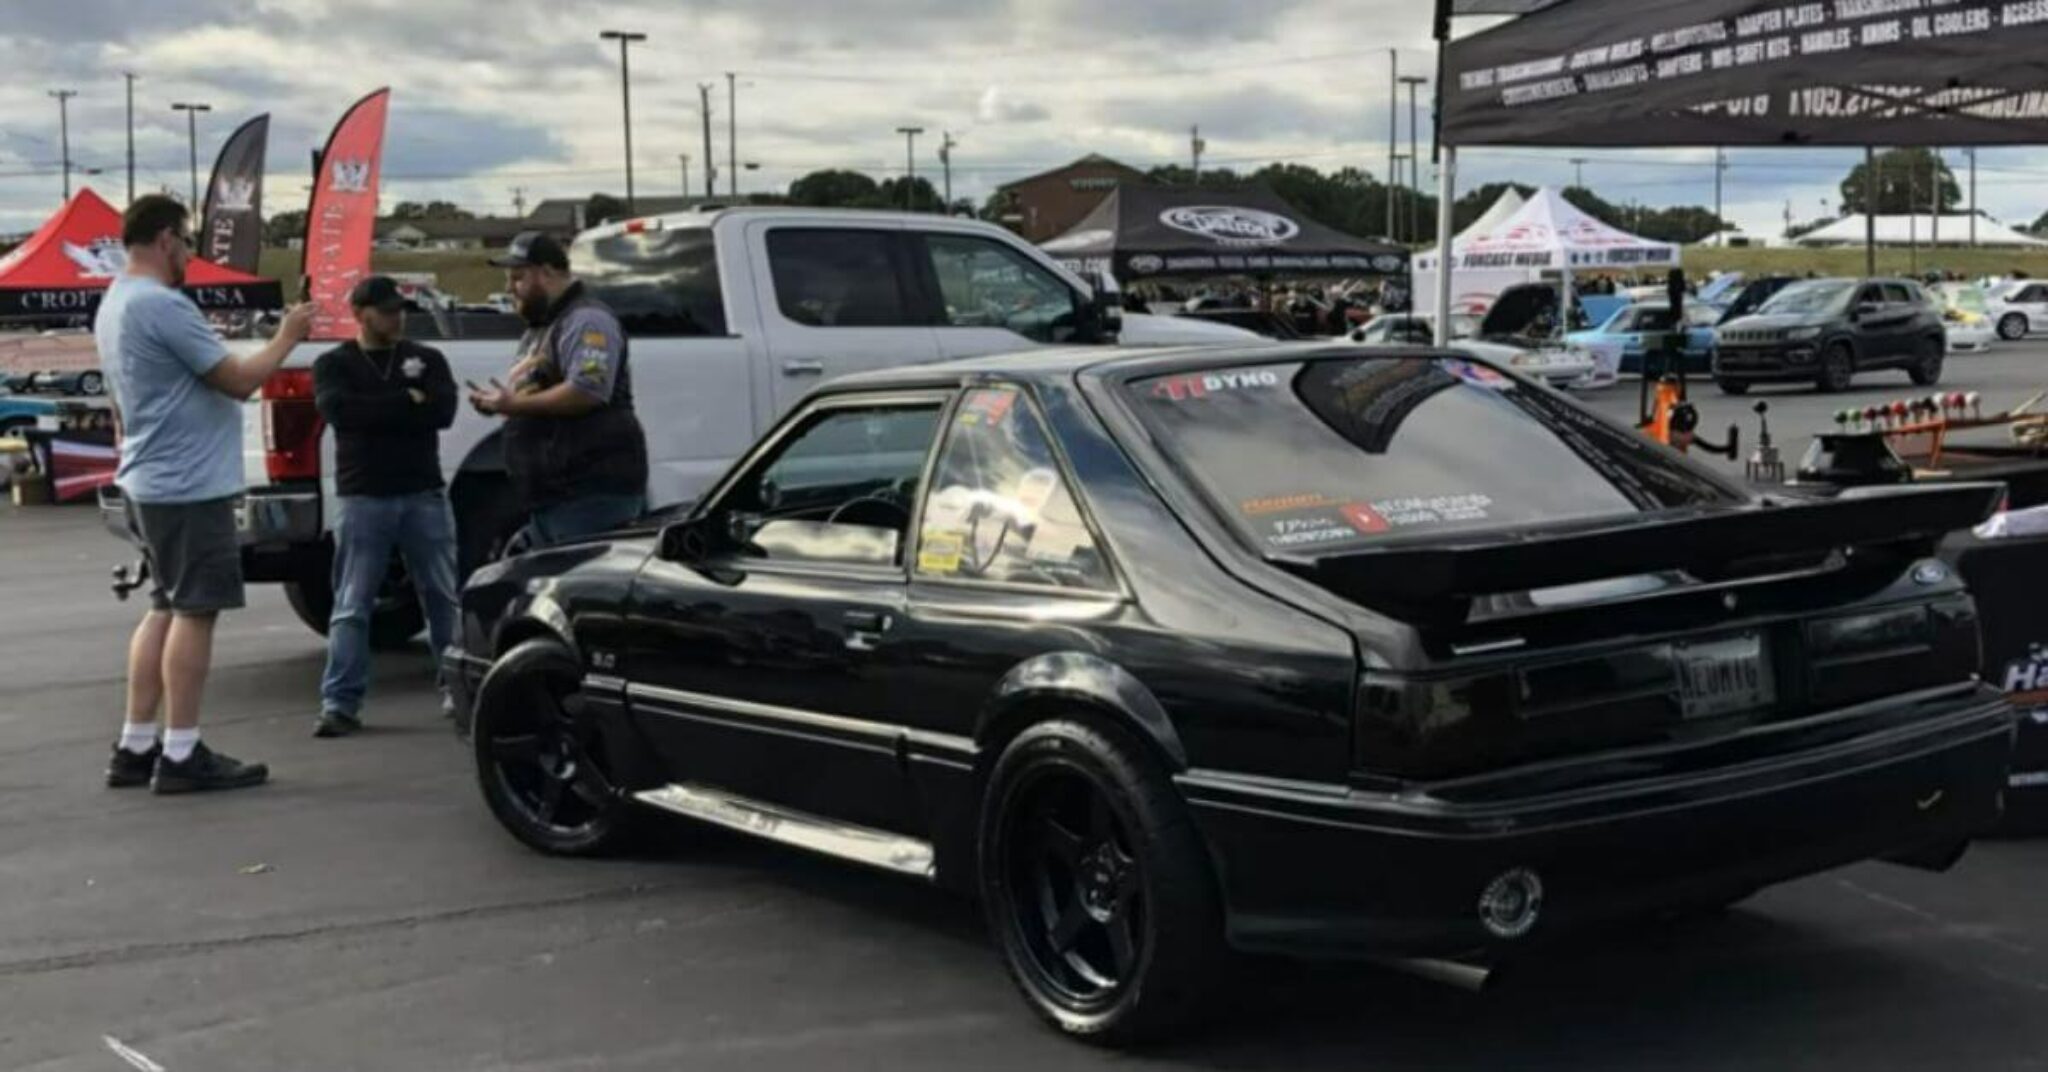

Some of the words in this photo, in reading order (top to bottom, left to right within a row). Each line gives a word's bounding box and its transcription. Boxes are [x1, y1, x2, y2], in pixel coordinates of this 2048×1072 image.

[1736, 10, 1782, 37] ADAPTER
[1785, 3, 1824, 27] PLATES
[1767, 36, 1790, 59] KITS
[1800, 27, 1850, 54] HANDLES
[1861, 20, 1900, 46] KNOBS
[1912, 16, 1932, 38] OIL
[1934, 8, 1989, 35] COOLERS
[197, 287, 245, 305] USA
[1203, 371, 1277, 391] DYNO
